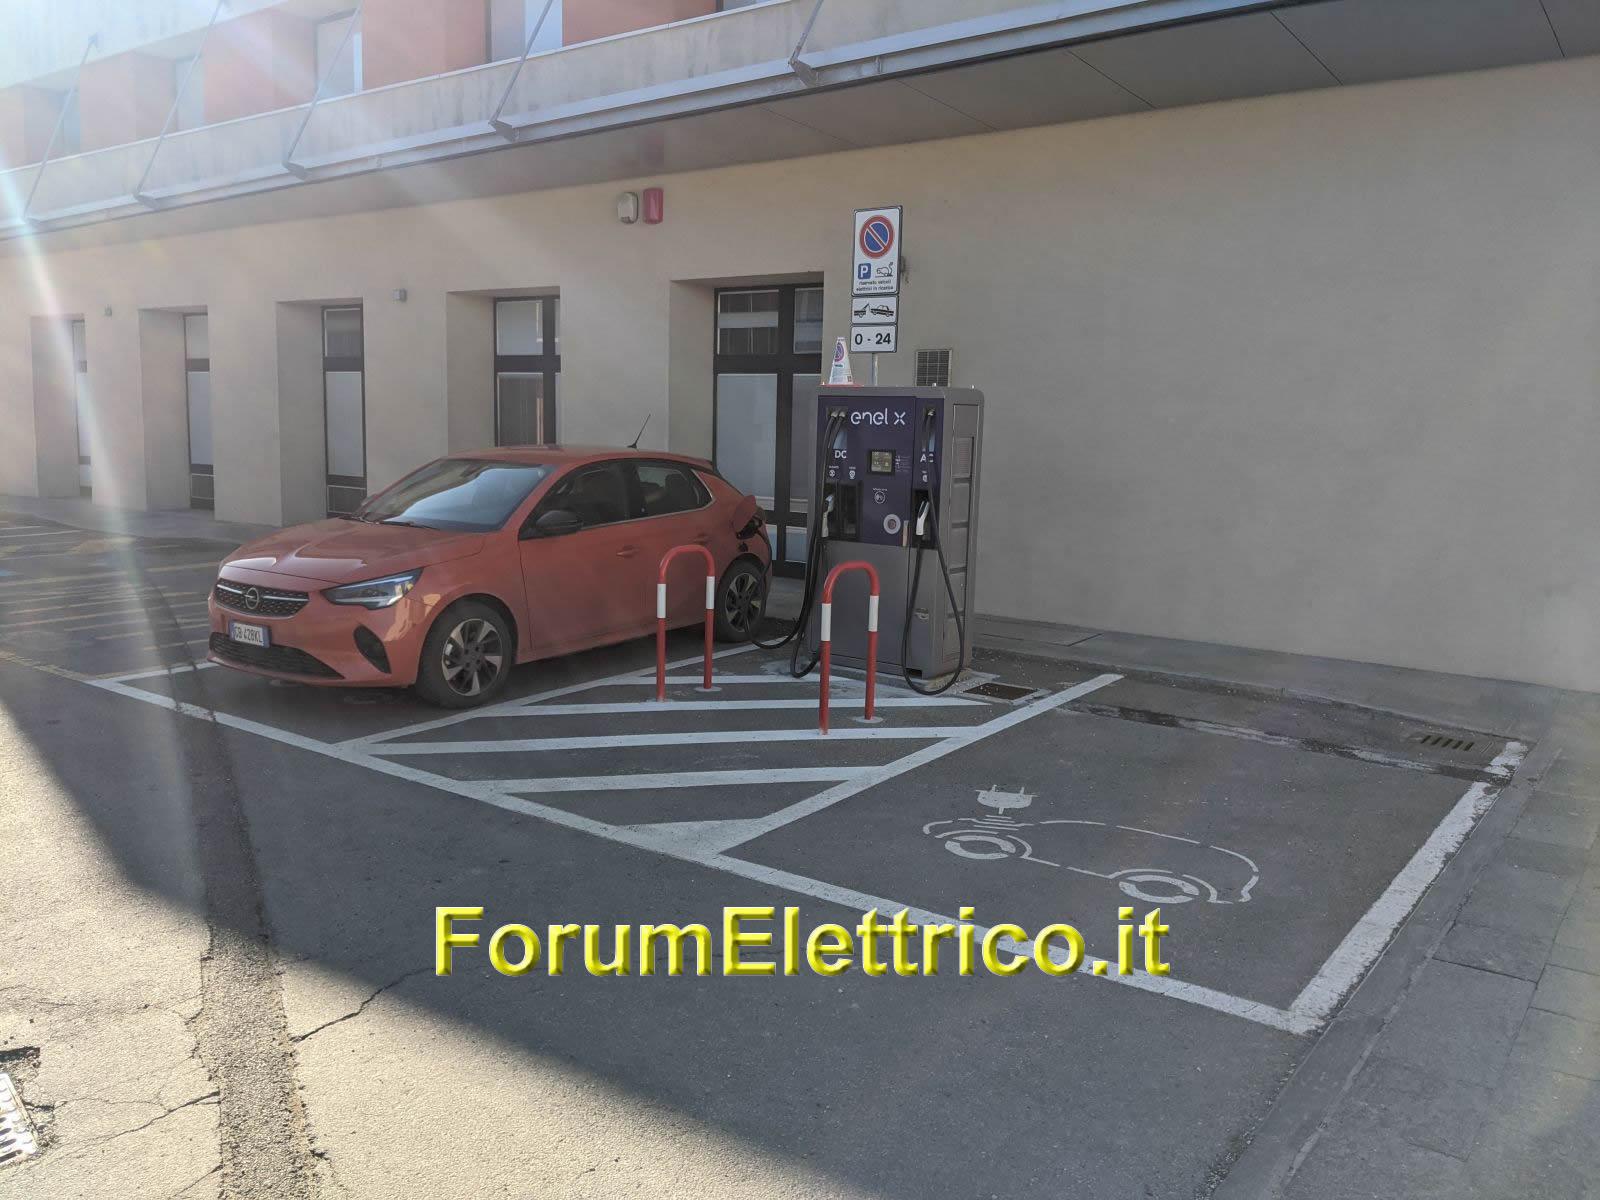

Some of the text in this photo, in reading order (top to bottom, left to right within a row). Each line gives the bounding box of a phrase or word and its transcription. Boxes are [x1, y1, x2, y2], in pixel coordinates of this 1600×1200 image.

[860, 265, 869, 278] P
[854, 333, 863, 345] 0
[875, 333, 891, 345] 24
[850, 407, 889, 425] enel
[834, 450, 847, 459] DC
